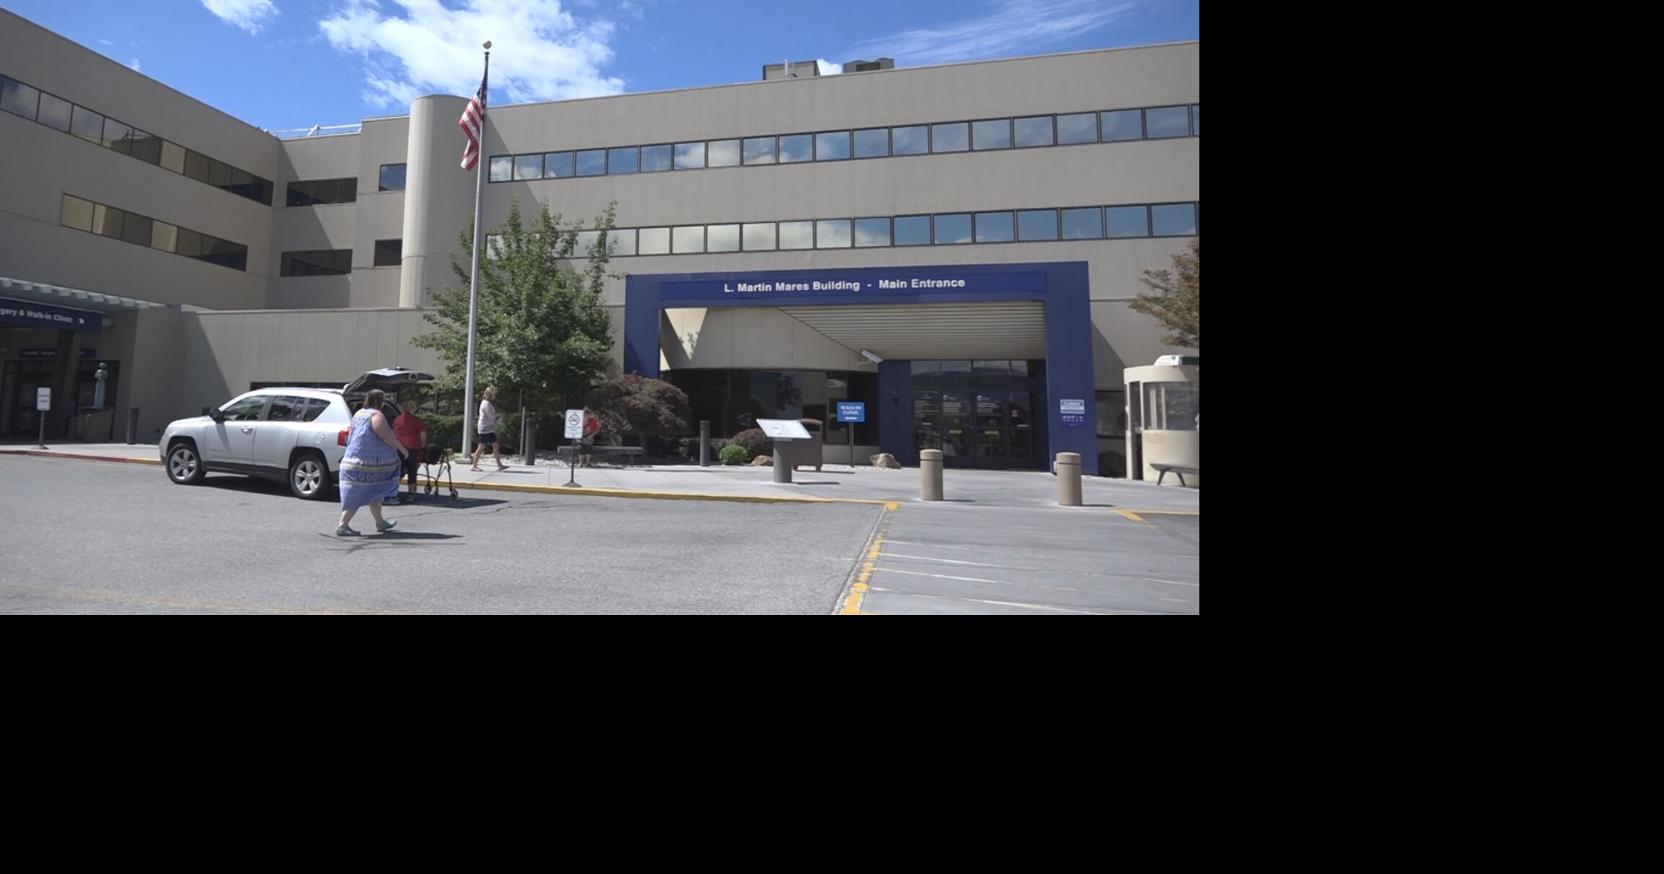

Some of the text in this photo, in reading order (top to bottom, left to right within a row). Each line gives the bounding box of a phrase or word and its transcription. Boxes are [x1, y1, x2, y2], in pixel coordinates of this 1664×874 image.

[724, 284, 734, 293] L.
[737, 282, 772, 292] Martin
[775, 282, 809, 291] Mares
[813, 280, 860, 292] Building
[878, 279, 907, 289] Main
[911, 278, 966, 288] Entrance
[0, 308, 17, 317] gery
[26, 310, 52, 320] Walk-in
[53, 313, 73, 324] Clinic
